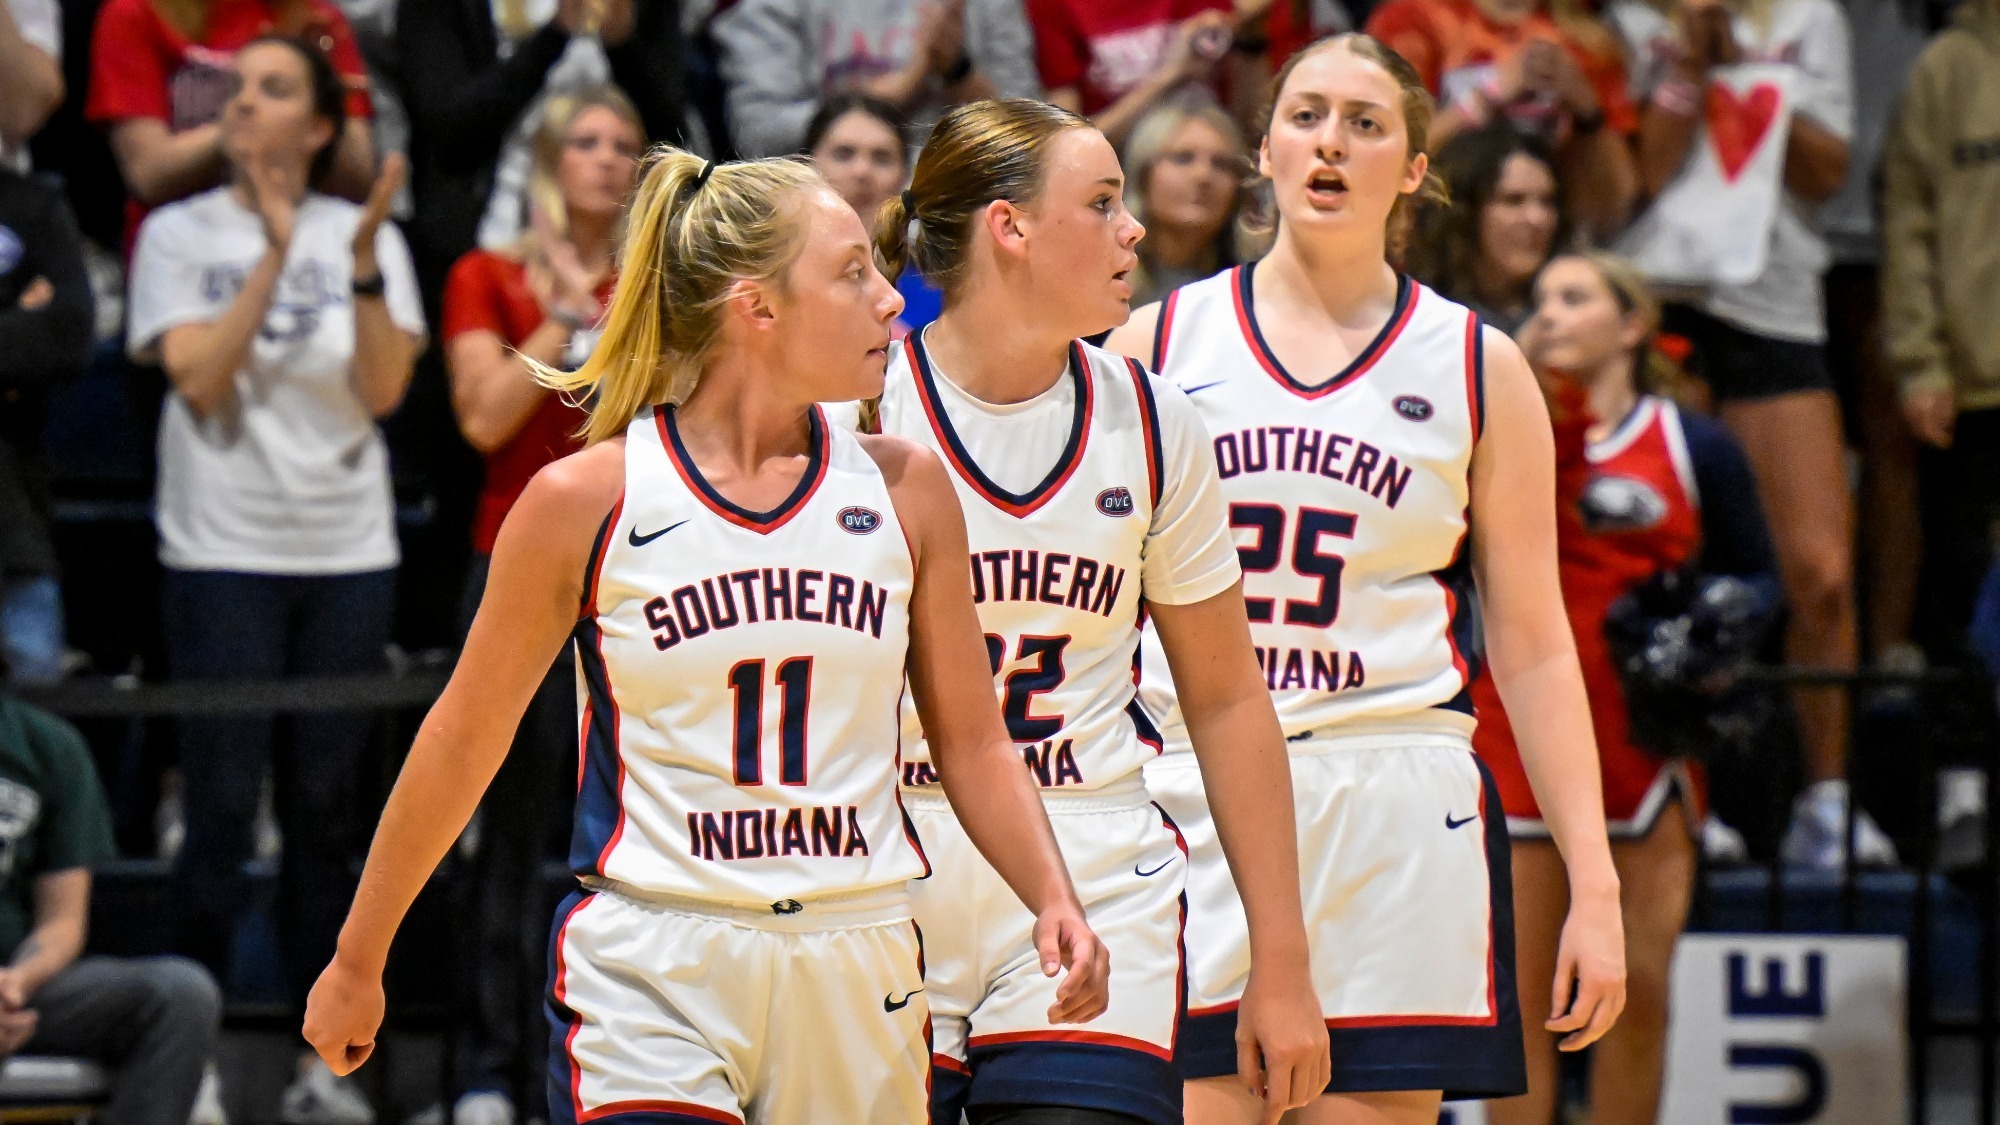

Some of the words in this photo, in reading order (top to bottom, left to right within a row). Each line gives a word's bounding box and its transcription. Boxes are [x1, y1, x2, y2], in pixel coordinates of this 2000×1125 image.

[1213, 426, 1412, 509] OUTHERN
[846, 514, 871, 526] OVC
[969, 549, 1126, 618] UTHERN
[1228, 502, 1359, 629] 25
[643, 567, 888, 651] SOUTHERN
[1254, 646, 1365, 693] IANA
[728, 655, 814, 787] 11
[687, 806, 869, 861] INDIANA
